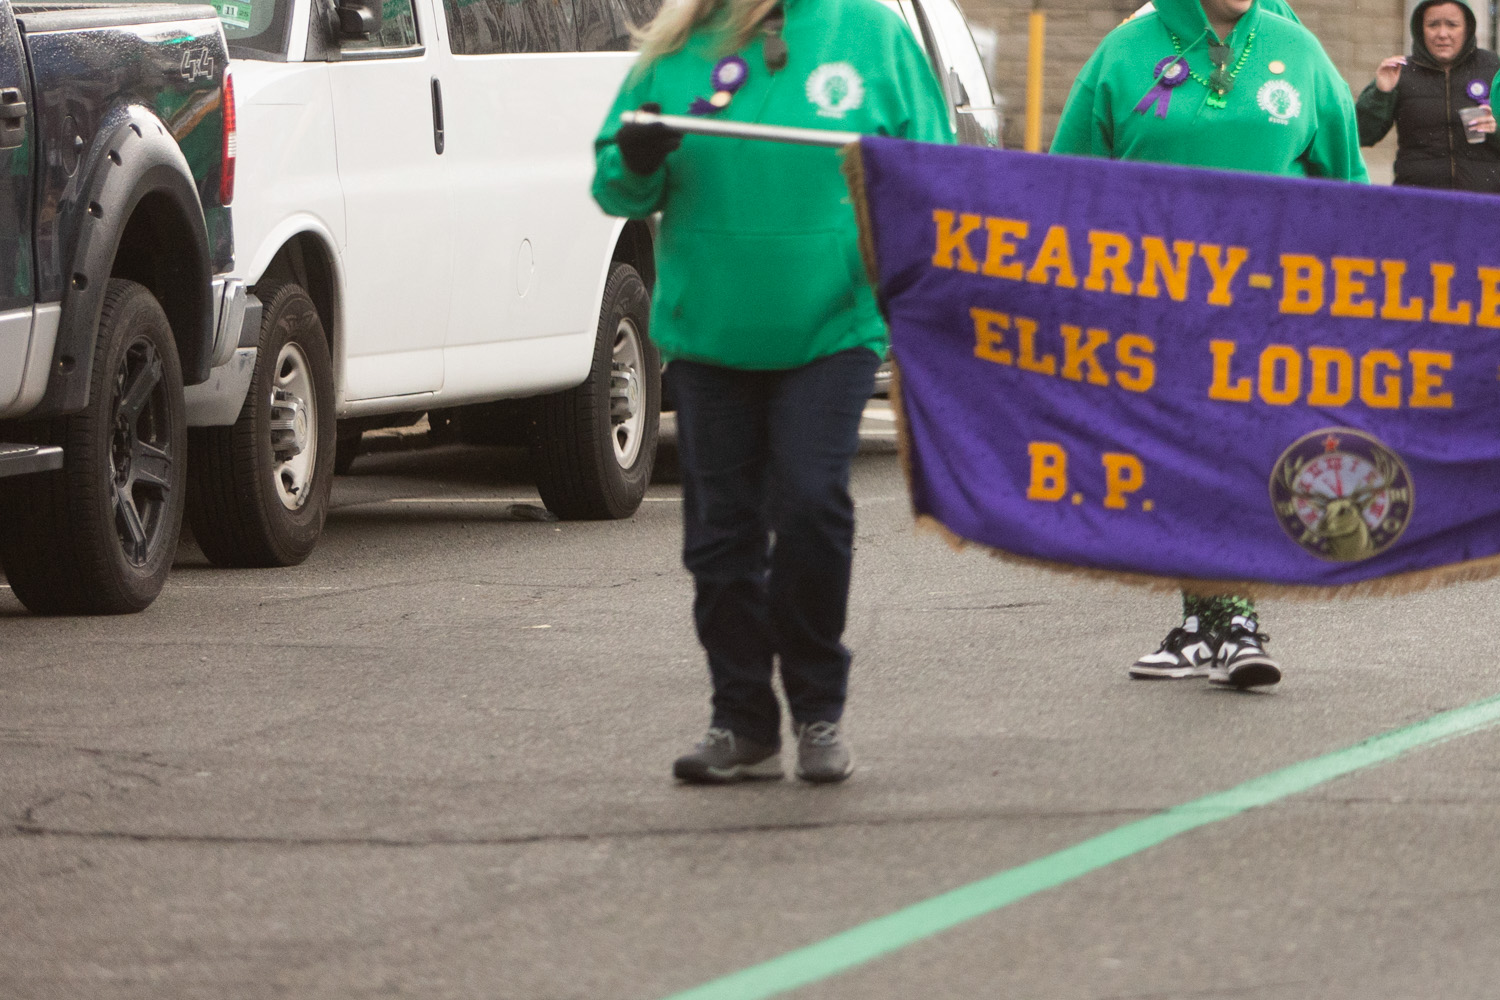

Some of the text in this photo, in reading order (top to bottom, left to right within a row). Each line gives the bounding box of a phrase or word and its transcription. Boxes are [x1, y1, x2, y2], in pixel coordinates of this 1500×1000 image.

[181, 46, 214, 82] 4x4
[969, 307, 1157, 393] ELKS
[1208, 339, 1454, 410] LODGE
